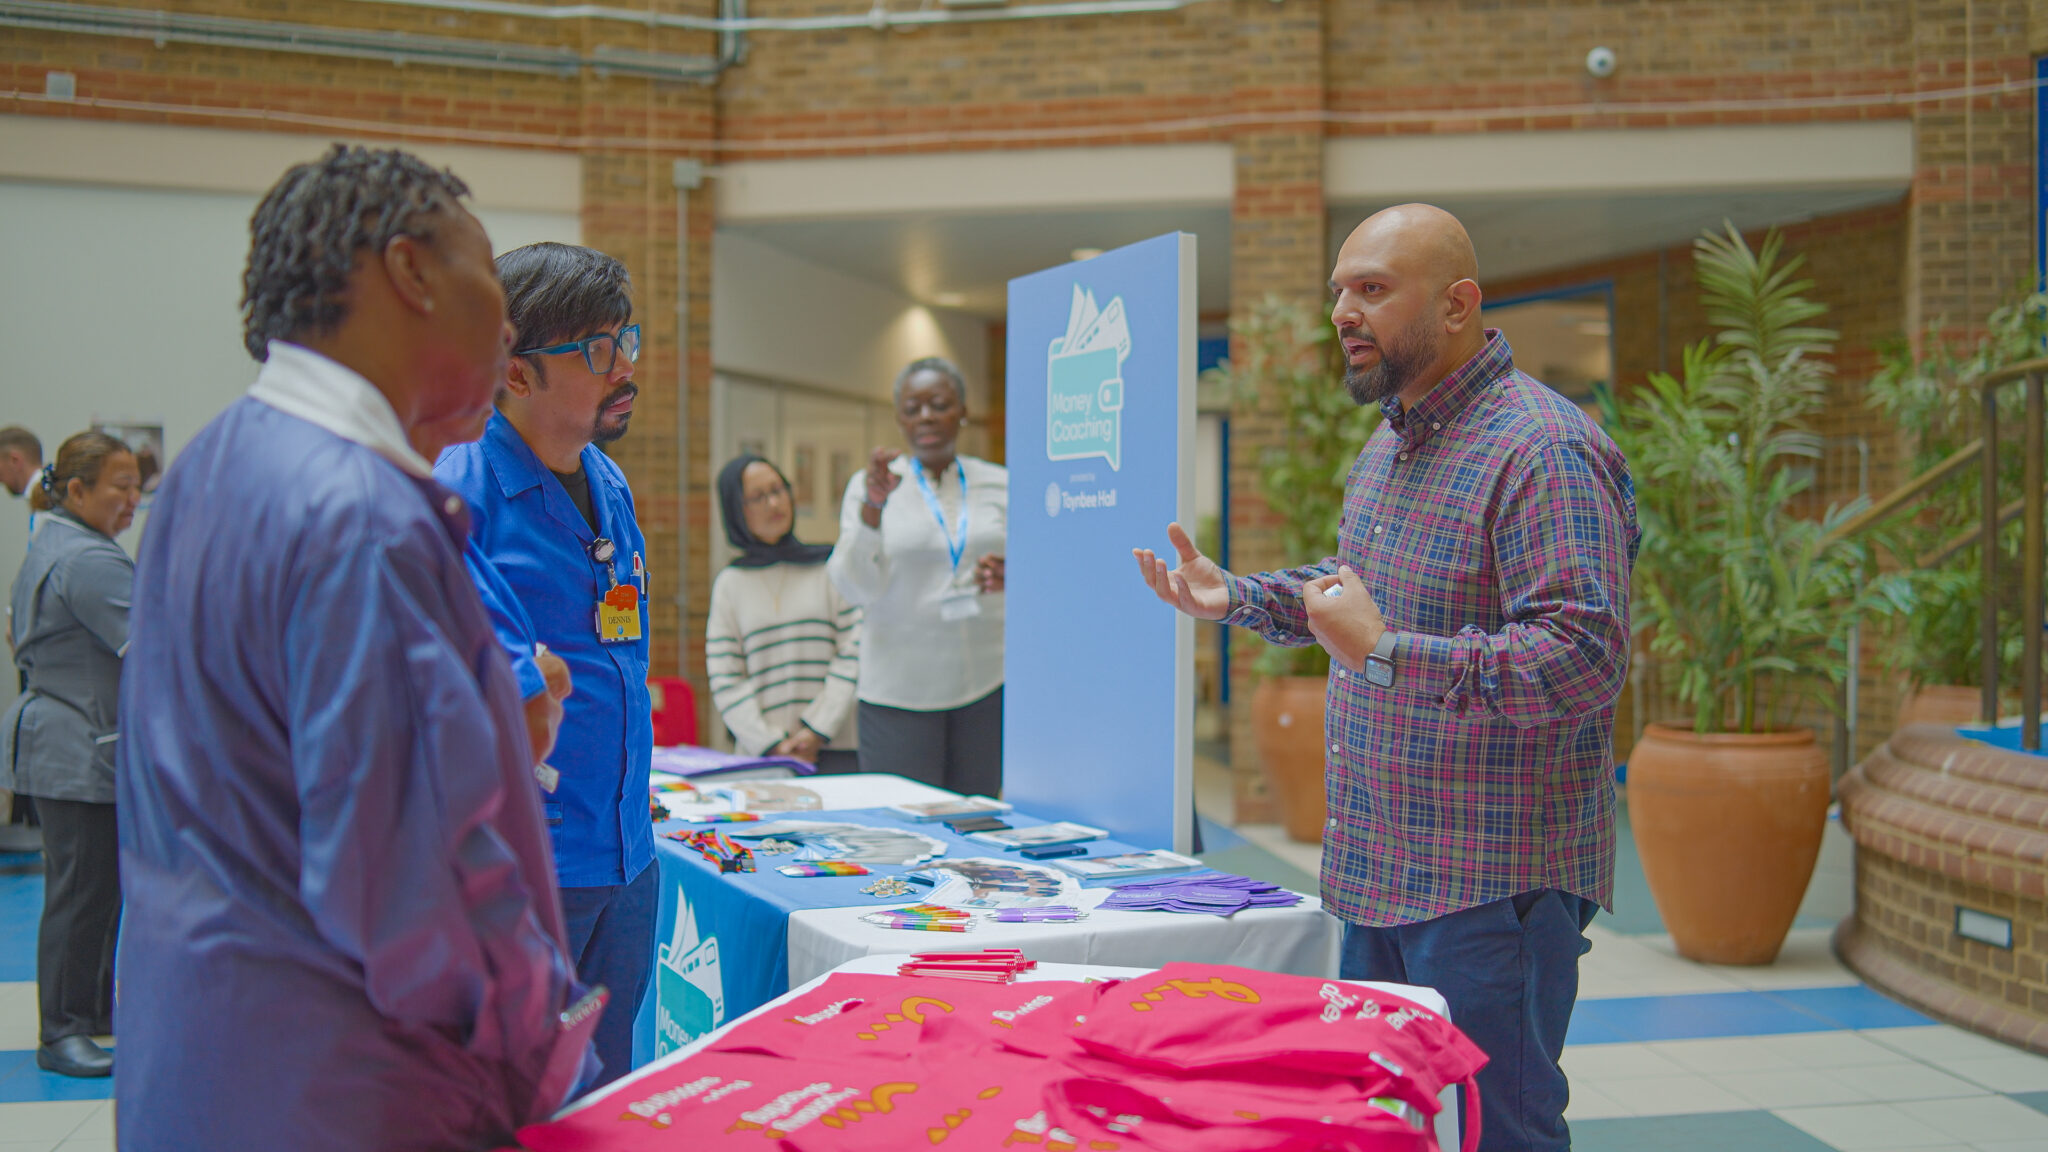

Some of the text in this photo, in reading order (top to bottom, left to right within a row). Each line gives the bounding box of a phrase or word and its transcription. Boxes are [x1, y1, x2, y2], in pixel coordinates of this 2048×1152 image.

[1053, 393, 1093, 416] Money
[1052, 415, 1112, 442] Coaching
[1062, 489, 1116, 511] Toynbee Hall
[608, 616, 631, 624] DENNIS
